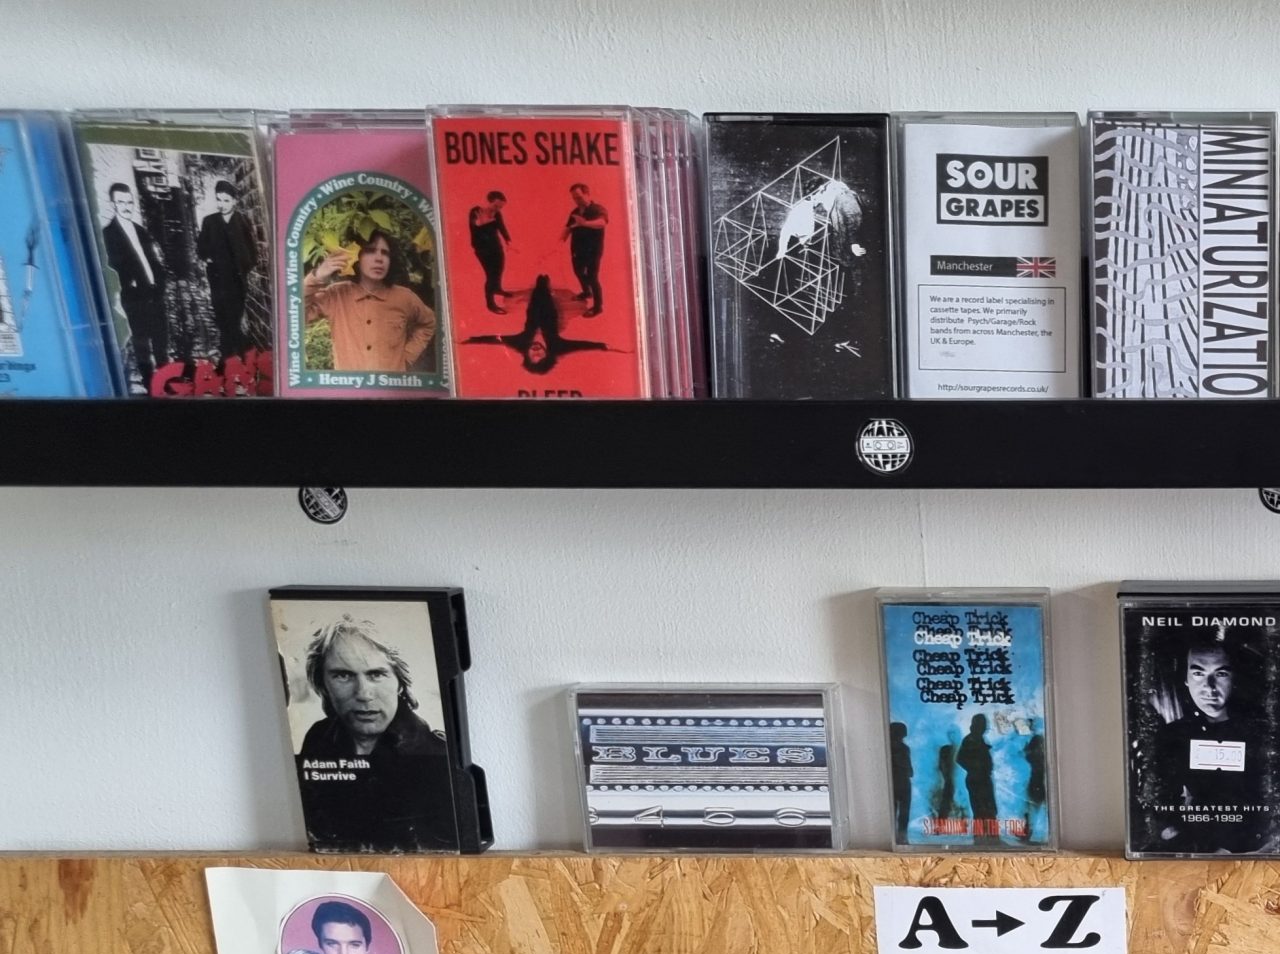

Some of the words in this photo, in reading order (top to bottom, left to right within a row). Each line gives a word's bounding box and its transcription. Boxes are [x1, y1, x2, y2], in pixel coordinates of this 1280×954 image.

[445, 133, 527, 165] BONES
[535, 133, 620, 165] SHAKE
[320, 175, 354, 196] Wine
[358, 174, 413, 199] Country
[946, 161, 1038, 190] SOUR
[946, 198, 1039, 218] GRAPES
[937, 261, 993, 271] Manchester
[289, 293, 301, 348] Country
[290, 351, 300, 386] Wine
[319, 375, 364, 388] Henry
[366, 375, 375, 386] J
[379, 375, 422, 387] Smith
[1142, 617, 1182, 626] NEIL
[1192, 617, 1276, 627] DIAMOND
[303, 759, 335, 770] Adam
[339, 759, 370, 769] Faith
[593, 746, 814, 763] BLUES
[899, 896, 969, 949] A
[1038, 895, 1101, 949] Z
